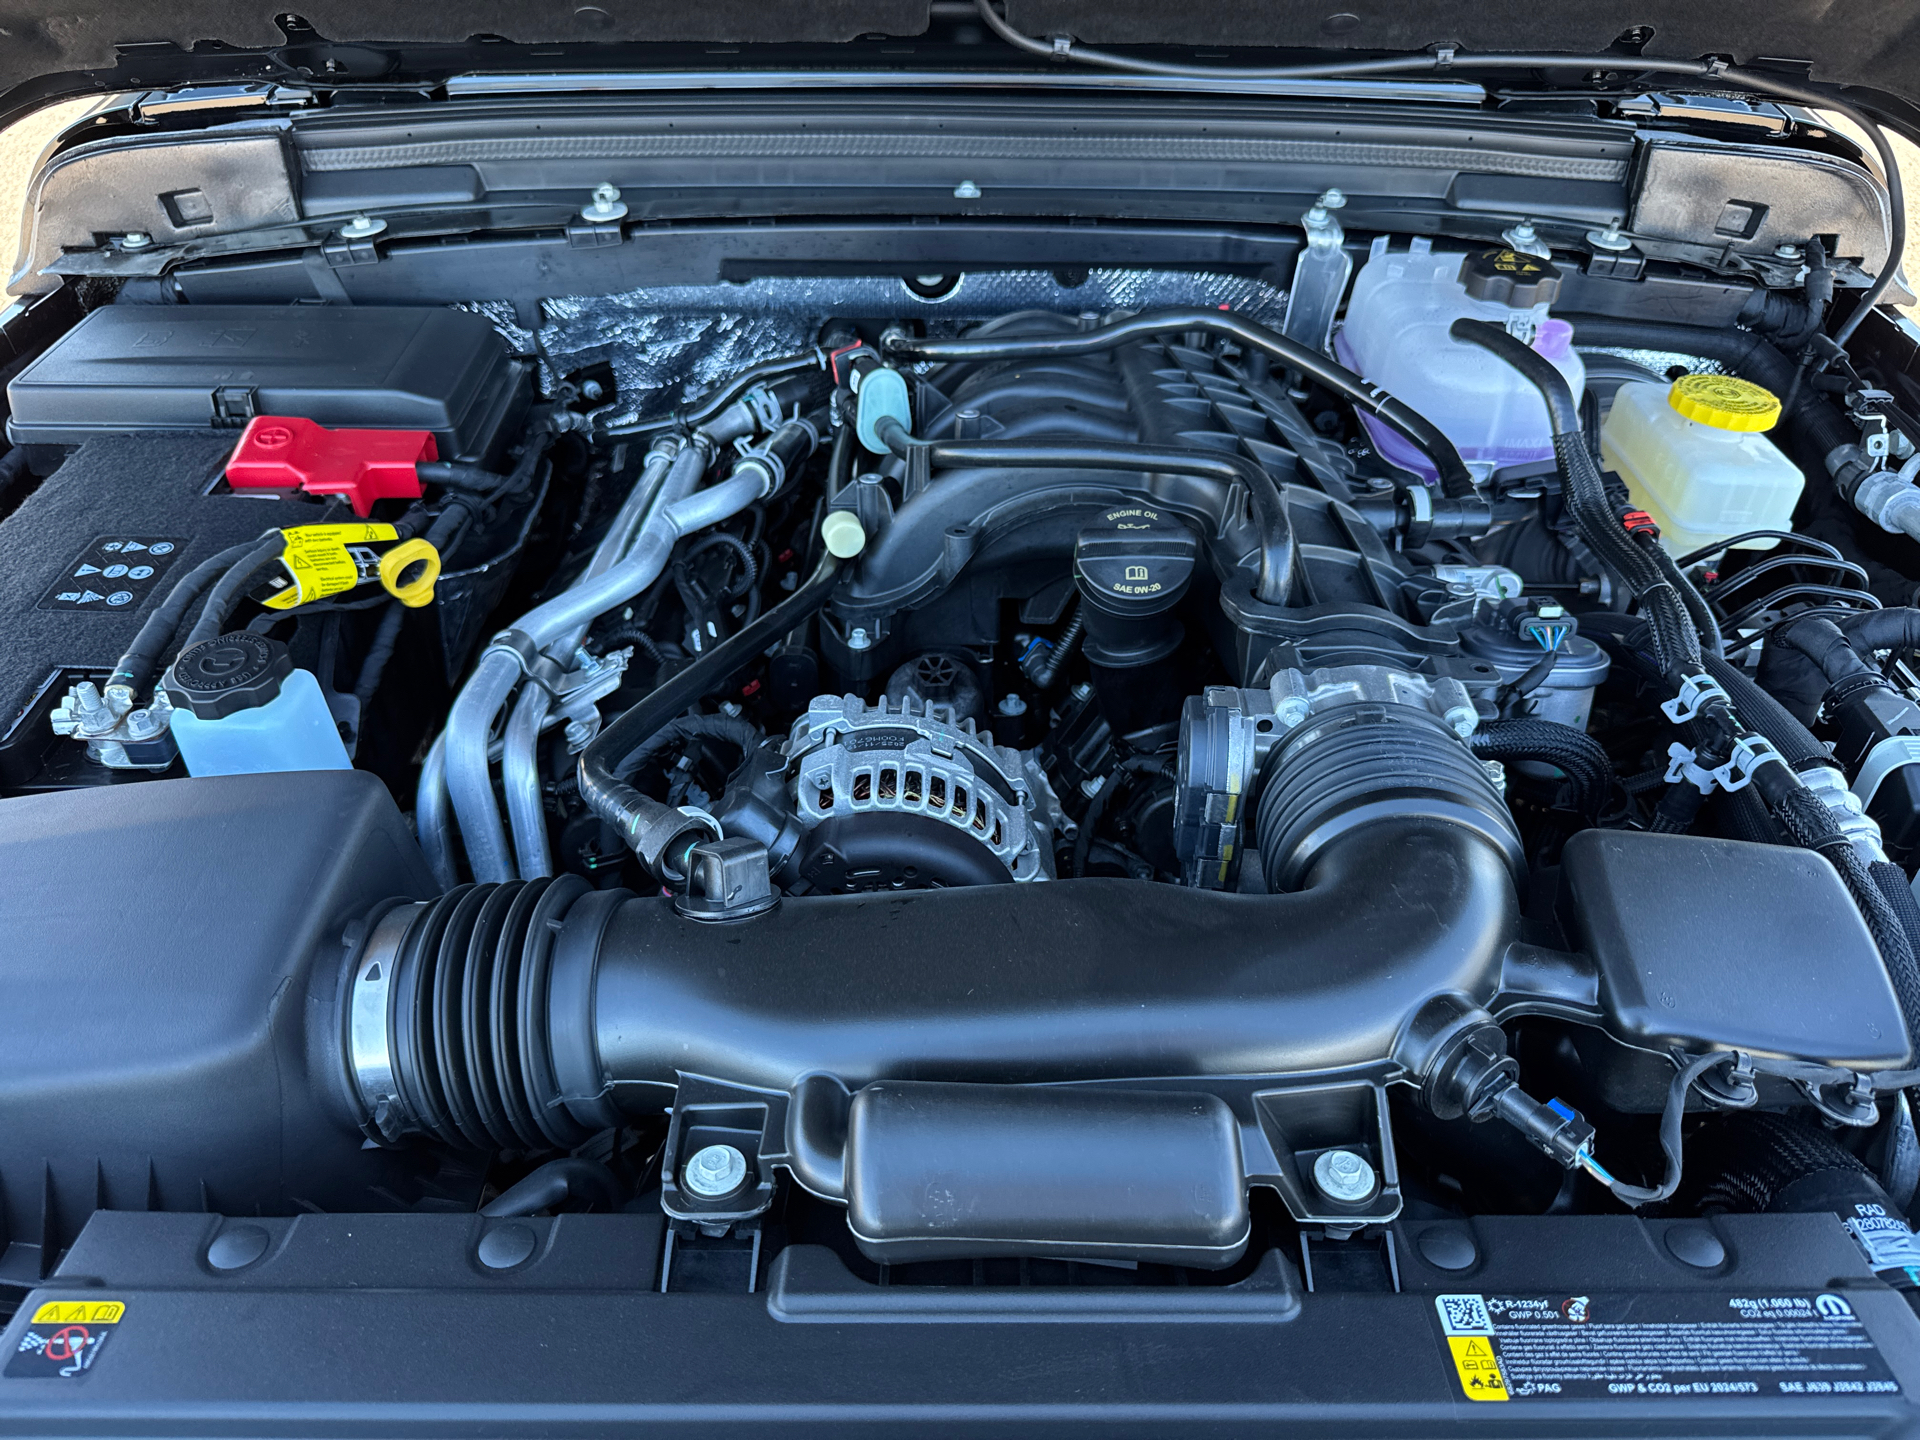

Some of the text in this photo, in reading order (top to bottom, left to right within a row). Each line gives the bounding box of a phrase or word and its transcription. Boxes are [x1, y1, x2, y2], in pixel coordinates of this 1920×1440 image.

[1106, 509, 1159, 521] ENGINE OIL
[1113, 583, 1162, 594] SAE 0W-20
[208, 634, 257, 647] STEERING
[182, 645, 206, 663] FLUID
[1854, 1204, 1885, 1216] RAD
[1505, 1299, 1549, 1311] R-1234yf
[1729, 1298, 1812, 1310] 482g (1.060 lb)
[1508, 1311, 1560, 1319] GWP 0.501
[1740, 1309, 1762, 1319] CO2
[1762, 1310, 1777, 1319] eq
[1537, 1383, 1562, 1394] PAG
[1608, 1383, 1635, 1394] GWP
[1637, 1383, 1647, 1393] &
[1647, 1383, 1672, 1394] CO2
[1673, 1384, 1691, 1395] per
[1692, 1382, 1710, 1393] EU
[1779, 1381, 1805, 1393] SAE
